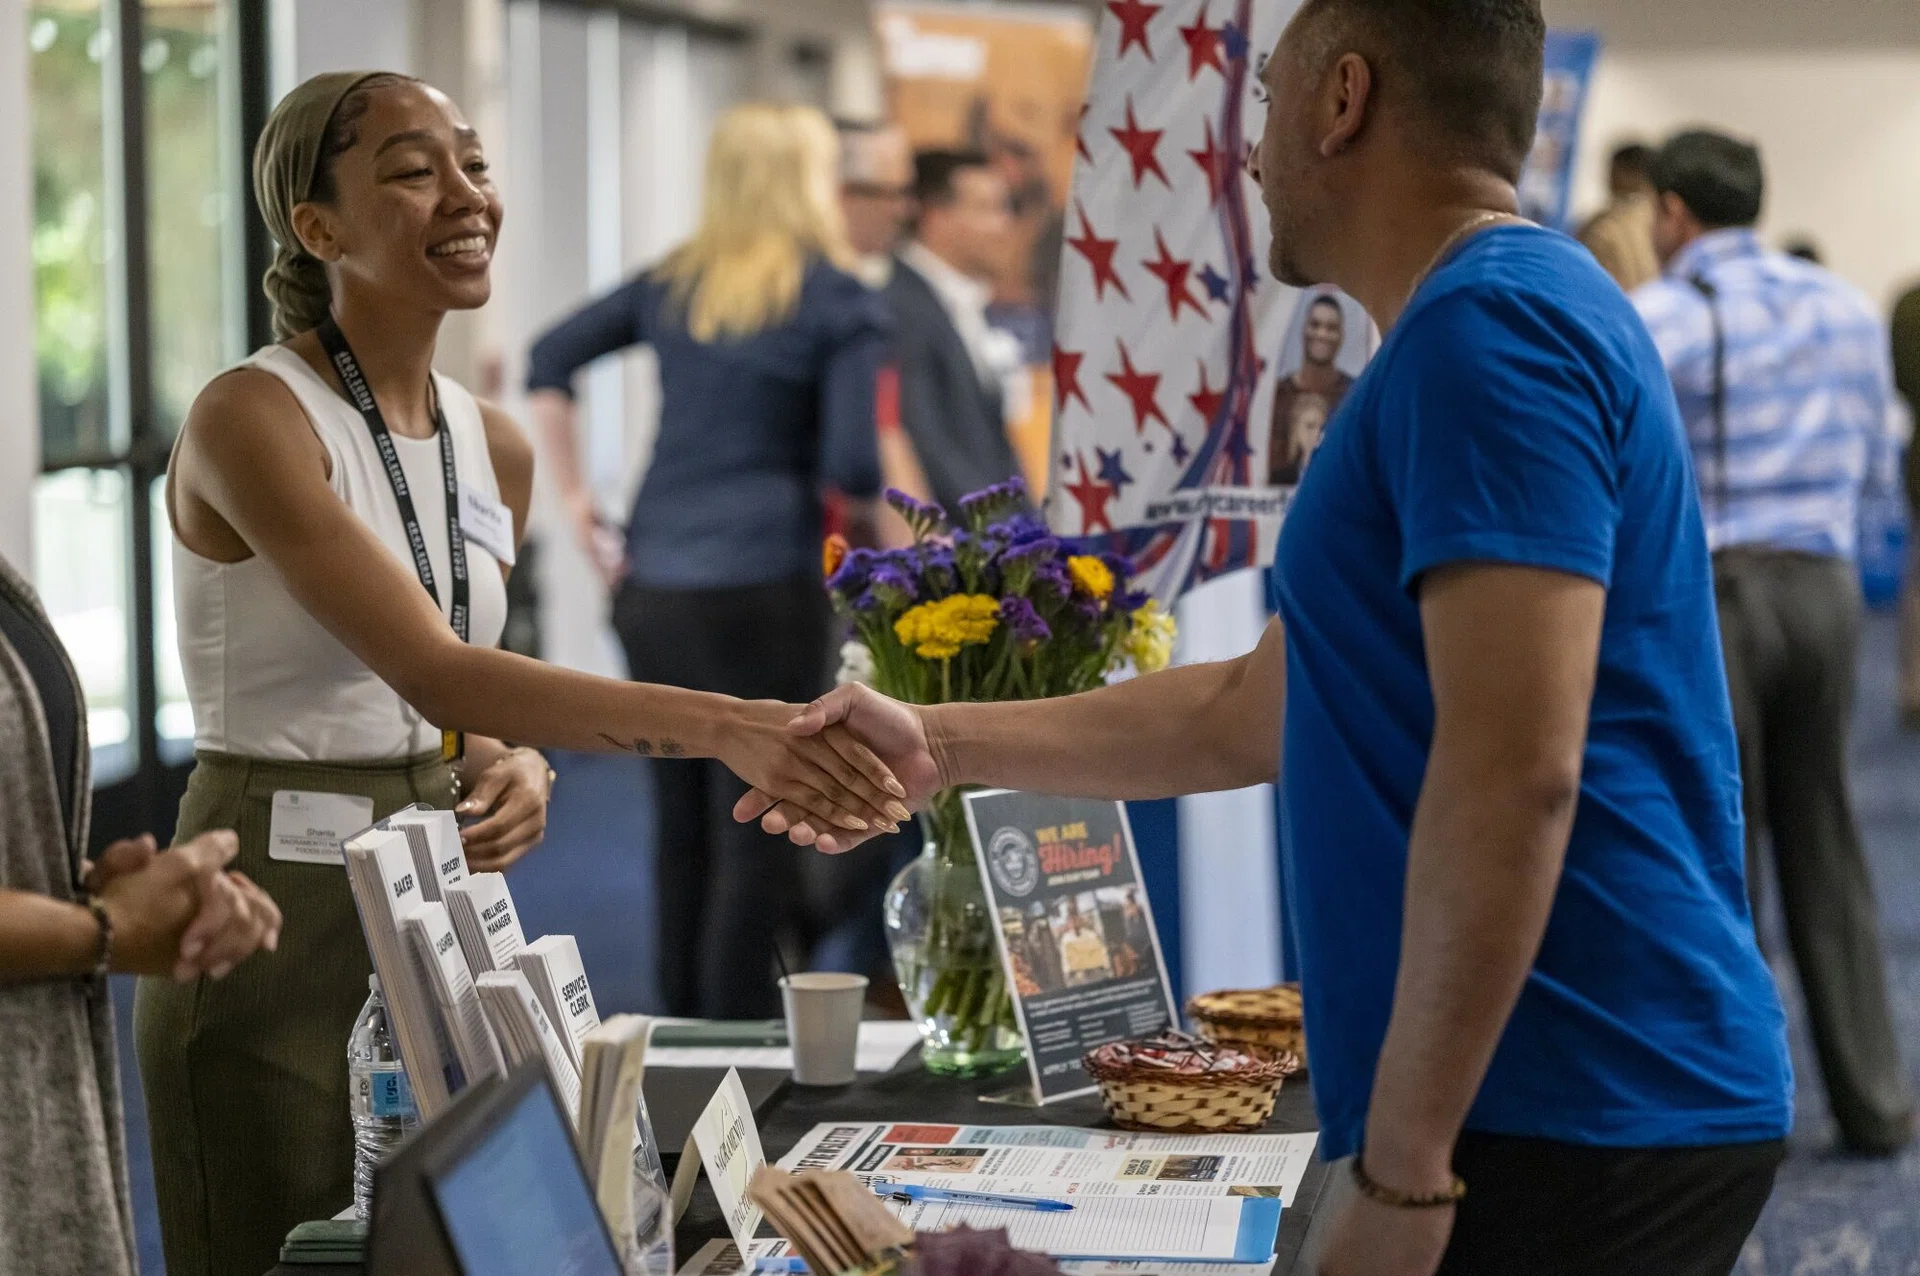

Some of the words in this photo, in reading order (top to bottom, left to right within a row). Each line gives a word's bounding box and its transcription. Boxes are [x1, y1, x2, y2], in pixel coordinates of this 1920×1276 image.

[1036, 826, 1059, 844] WE
[1061, 822, 1088, 840] ARE
[441, 856, 461, 876] GROCERY
[393, 873, 415, 898] BAKER
[481, 898, 508, 923] WELLNESS
[487, 913, 513, 937] MANAGER
[436, 931, 455, 956] CASHIER
[562, 974, 588, 1002] SERVICE
[569, 993, 591, 1018] CLERK
[714, 1115, 746, 1177] SACRAMENTO
